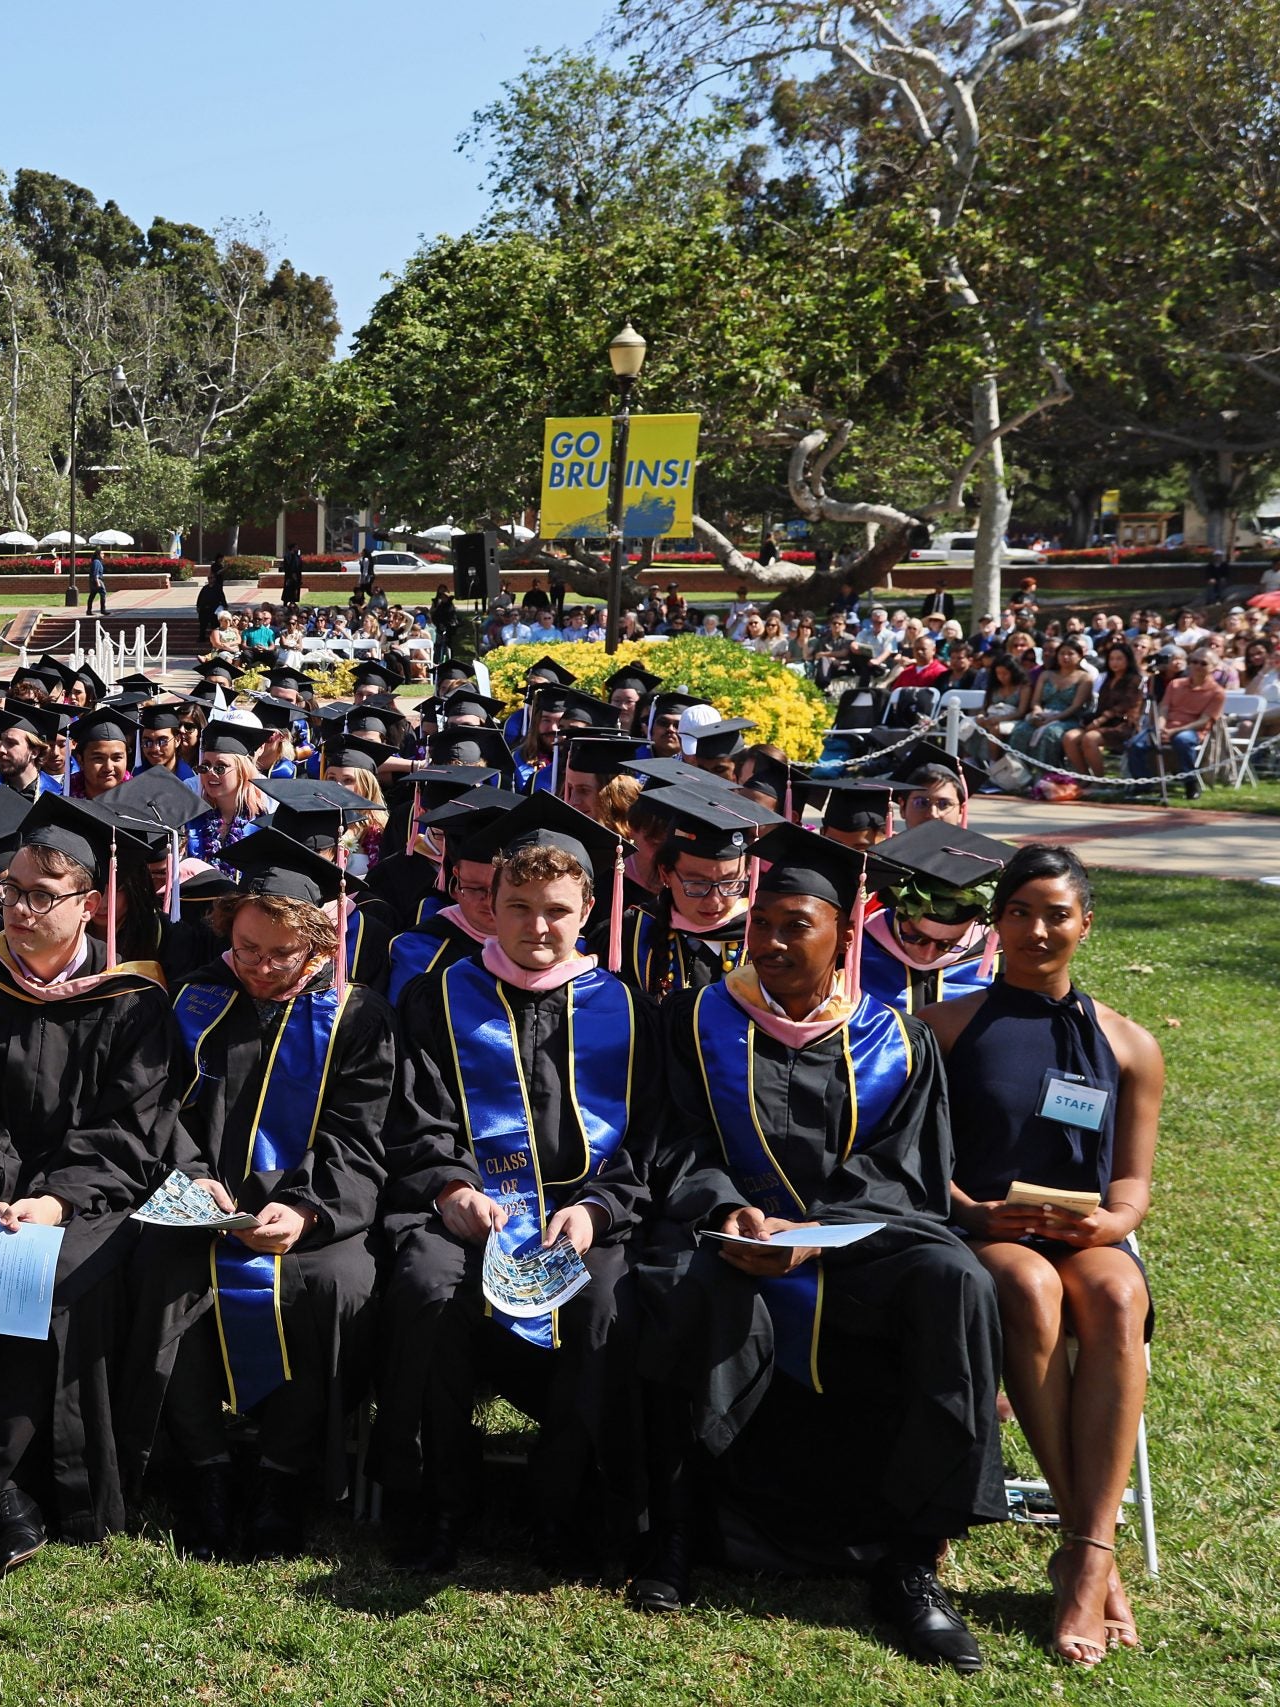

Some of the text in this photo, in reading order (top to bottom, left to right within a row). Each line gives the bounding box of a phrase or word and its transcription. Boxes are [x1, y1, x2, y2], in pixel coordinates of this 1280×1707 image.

[551, 431, 601, 459] GO
[1055, 1095, 1095, 1112] STAFF
[486, 1152, 527, 1174] CLASS
[500, 1178, 519, 1196] OF
[502, 1199, 528, 1216] 023
